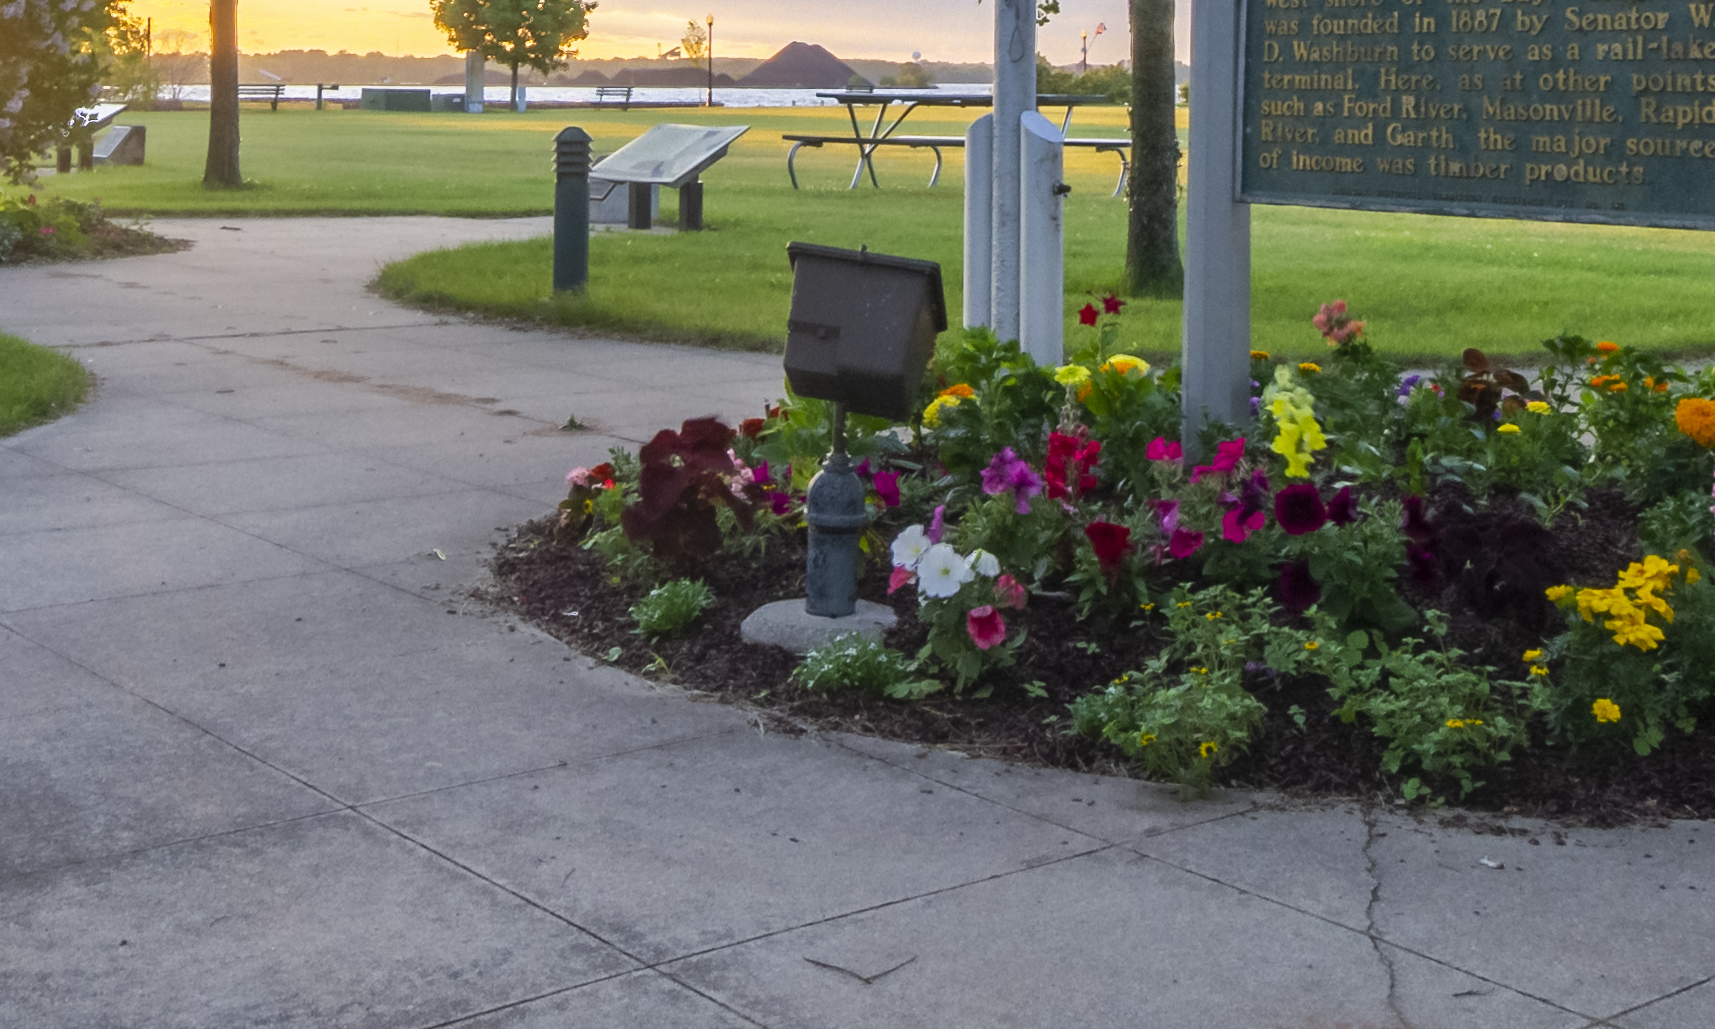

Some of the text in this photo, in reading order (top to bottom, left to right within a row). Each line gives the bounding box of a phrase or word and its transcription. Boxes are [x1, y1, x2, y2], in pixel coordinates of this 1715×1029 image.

[1265, 18, 1300, 36] was
[1312, 11, 1399, 35] founded
[1414, 12, 1436, 33] in
[1450, 8, 1502, 33] 1887
[1516, 8, 1549, 36] by
[1564, 6, 1669, 31] Senator
[1263, 41, 1283, 62] D.
[1293, 40, 1399, 63] Washburn
[1411, 41, 1435, 61] to
[1448, 43, 1513, 62] serve
[1527, 42, 1552, 61] as
[1566, 42, 1580, 61] a
[1263, 68, 1360, 91] terminal.
[1380, 67, 1441, 91] Here,
[1458, 73, 1483, 90] as
[1501, 70, 1524, 92] at
[1539, 68, 1612, 92] other
[1261, 95, 1305, 116] such
[1313, 100, 1335, 117] as
[1342, 94, 1393, 118] Ford
[1400, 95, 1467, 119] River,
[1483, 95, 1623, 123] Masonville,
[1334, 122, 1374, 145] and
[1478, 126, 1517, 151] the
[1531, 128, 1611, 158] major
[1258, 148, 1282, 169] of
[1291, 150, 1364, 173] income
[1377, 157, 1416, 175] was
[1428, 155, 1511, 179] timber
